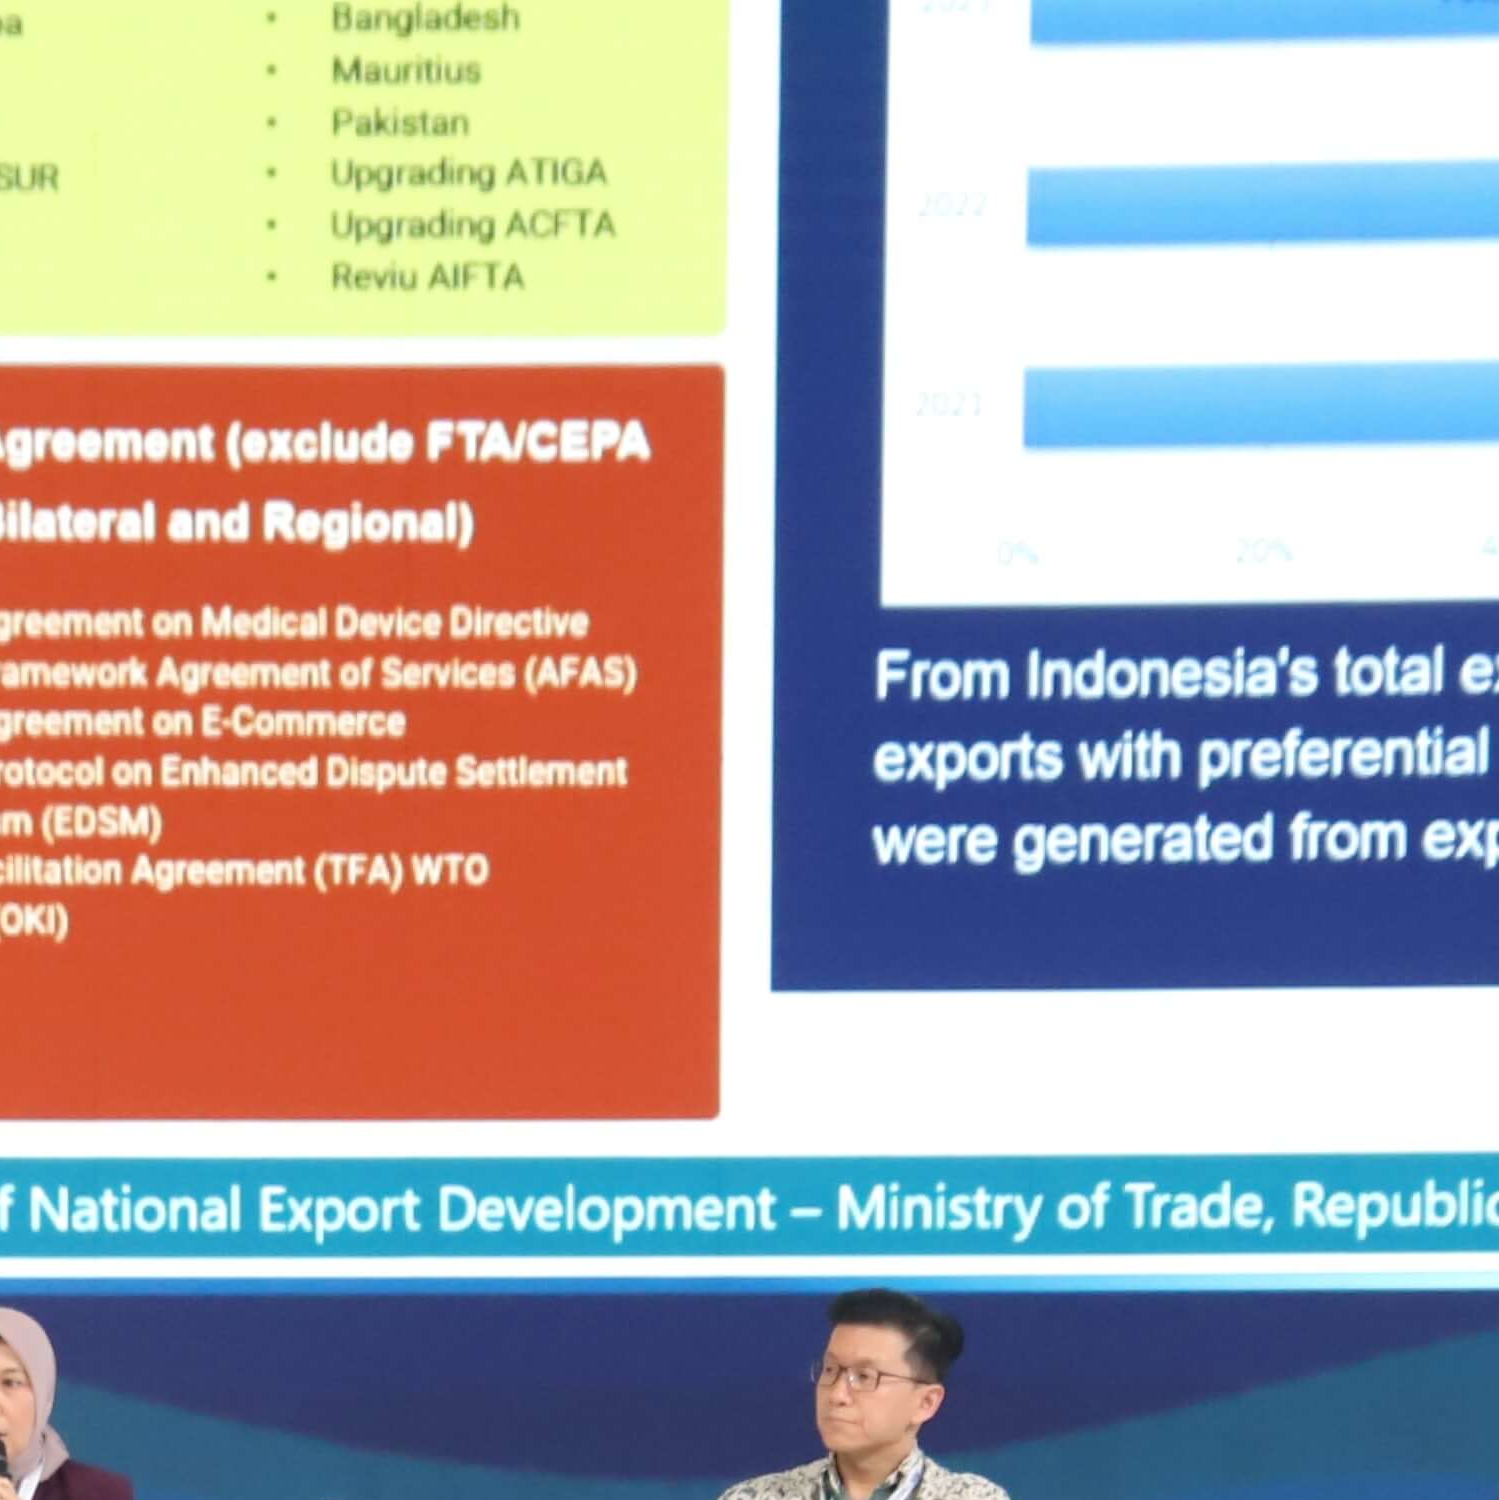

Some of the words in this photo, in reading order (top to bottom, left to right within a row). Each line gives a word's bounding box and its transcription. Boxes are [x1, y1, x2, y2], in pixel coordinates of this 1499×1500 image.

[333, 1, 520, 39] Bangladesh
[333, 56, 481, 85] Mauritius
[333, 107, 469, 137] Pakistan
[331, 156, 496, 194] Upgrading
[506, 157, 607, 185] ATIGA
[331, 208, 495, 246] Upgrading
[505, 208, 616, 238] ACFTA
[332, 262, 418, 291] Reviu
[428, 261, 525, 290] AIFTA
[226, 420, 415, 470] (exclude
[427, 419, 651, 462] FTA/CEPA
[167, 500, 250, 542] and
[263, 499, 474, 552] Regional)
[152, 611, 193, 639] on
[201, 604, 327, 639] Medical
[335, 604, 443, 640] Device
[450, 604, 590, 639] Directive
[156, 656, 331, 696] Agreement
[339, 656, 374, 689] of
[381, 655, 516, 689] Services
[524, 654, 637, 695] (AFAS)
[877, 648, 1009, 700] From
[1028, 645, 1319, 699] Indonesia's
[1334, 644, 1444, 696] total
[152, 710, 193, 737] on
[202, 704, 406, 738] E-Commerce
[111, 760, 153, 787] on
[161, 753, 319, 788] Enhanced
[326, 754, 448, 794] Dispute
[456, 754, 628, 788] Settlement
[874, 732, 1064, 791] exports
[1077, 729, 1182, 780] with
[1199, 725, 1489, 789] preferential
[41, 804, 162, 845] (EDSM)
[872, 824, 998, 865] were
[1013, 811, 1273, 875] generated
[1289, 810, 1407, 861] from
[131, 853, 306, 892] Agreement
[314, 852, 404, 893] (TFA)
[411, 853, 489, 886] WTO
[30, 1184, 240, 1232] National
[260, 1185, 421, 1244] Export
[440, 1184, 777, 1244] Development
[838, 1182, 1043, 1242] Ministry
[1057, 1181, 1111, 1230] of
[1123, 1181, 1274, 1234] Trade,
